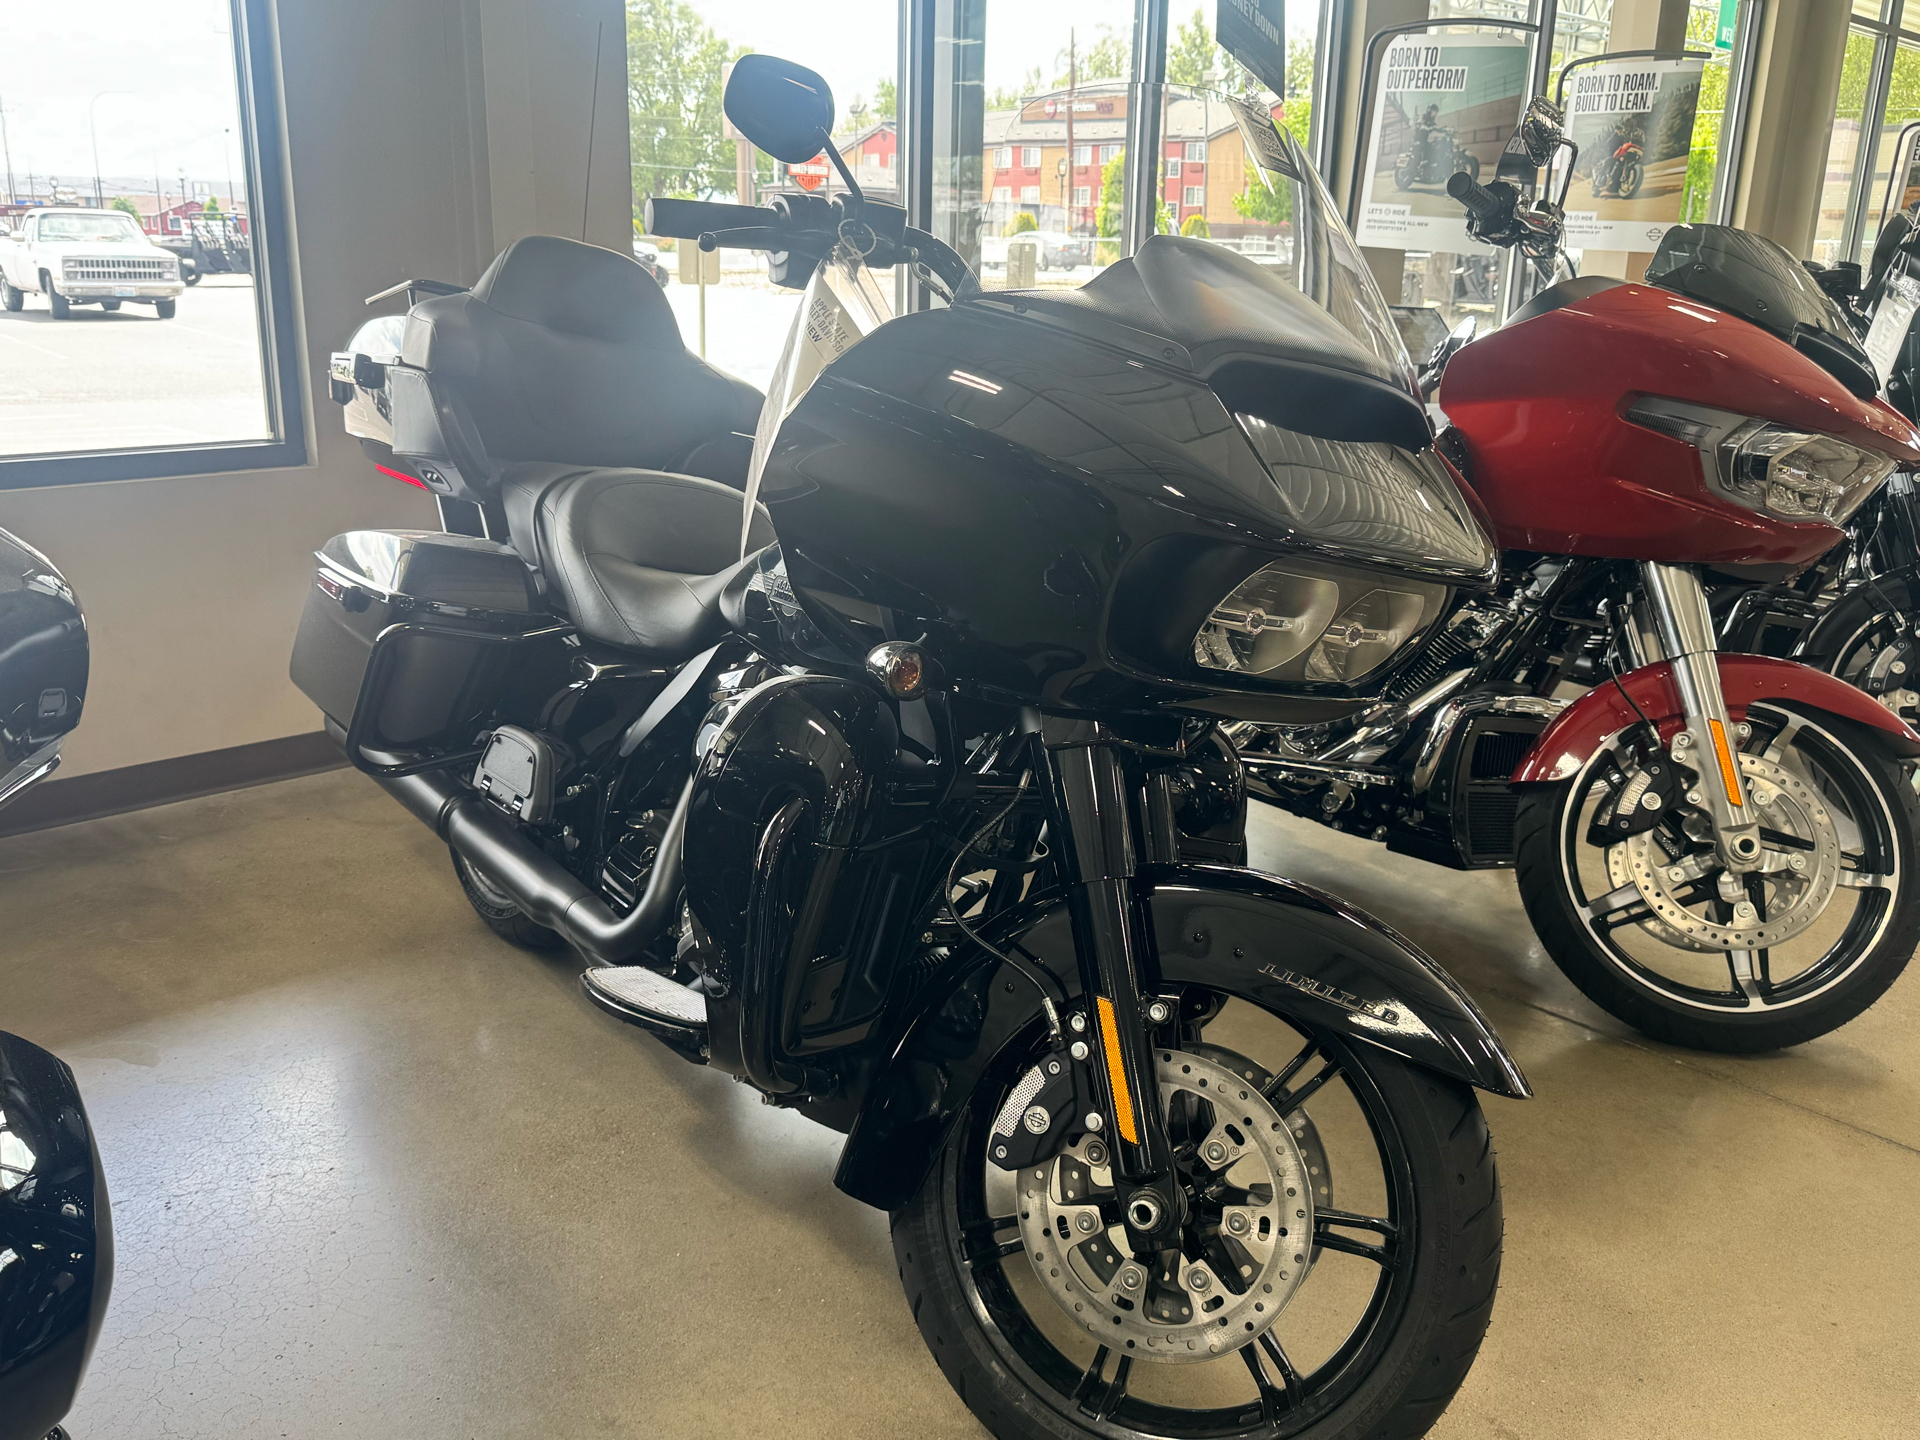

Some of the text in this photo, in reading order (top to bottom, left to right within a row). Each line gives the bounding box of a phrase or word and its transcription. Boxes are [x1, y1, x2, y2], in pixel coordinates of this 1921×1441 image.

[1229, 0, 1254, 20] ONEY
[1255, 9, 1279, 46] DOWN
[1389, 46, 1439, 68] BORN TO
[1386, 68, 1466, 90] OUTPERFORM
[1577, 72, 1659, 94] BORN TO ROAM.
[1575, 91, 1650, 112] BUILT TO LEAN.
[1367, 207, 1383, 215] LET'S
[808, 304, 844, 353] RLEY-DAVIDSO
[813, 297, 850, 342] APPLE STATE
[806, 321, 823, 343] NEW
[1257, 962, 1400, 1026] LIMITED
